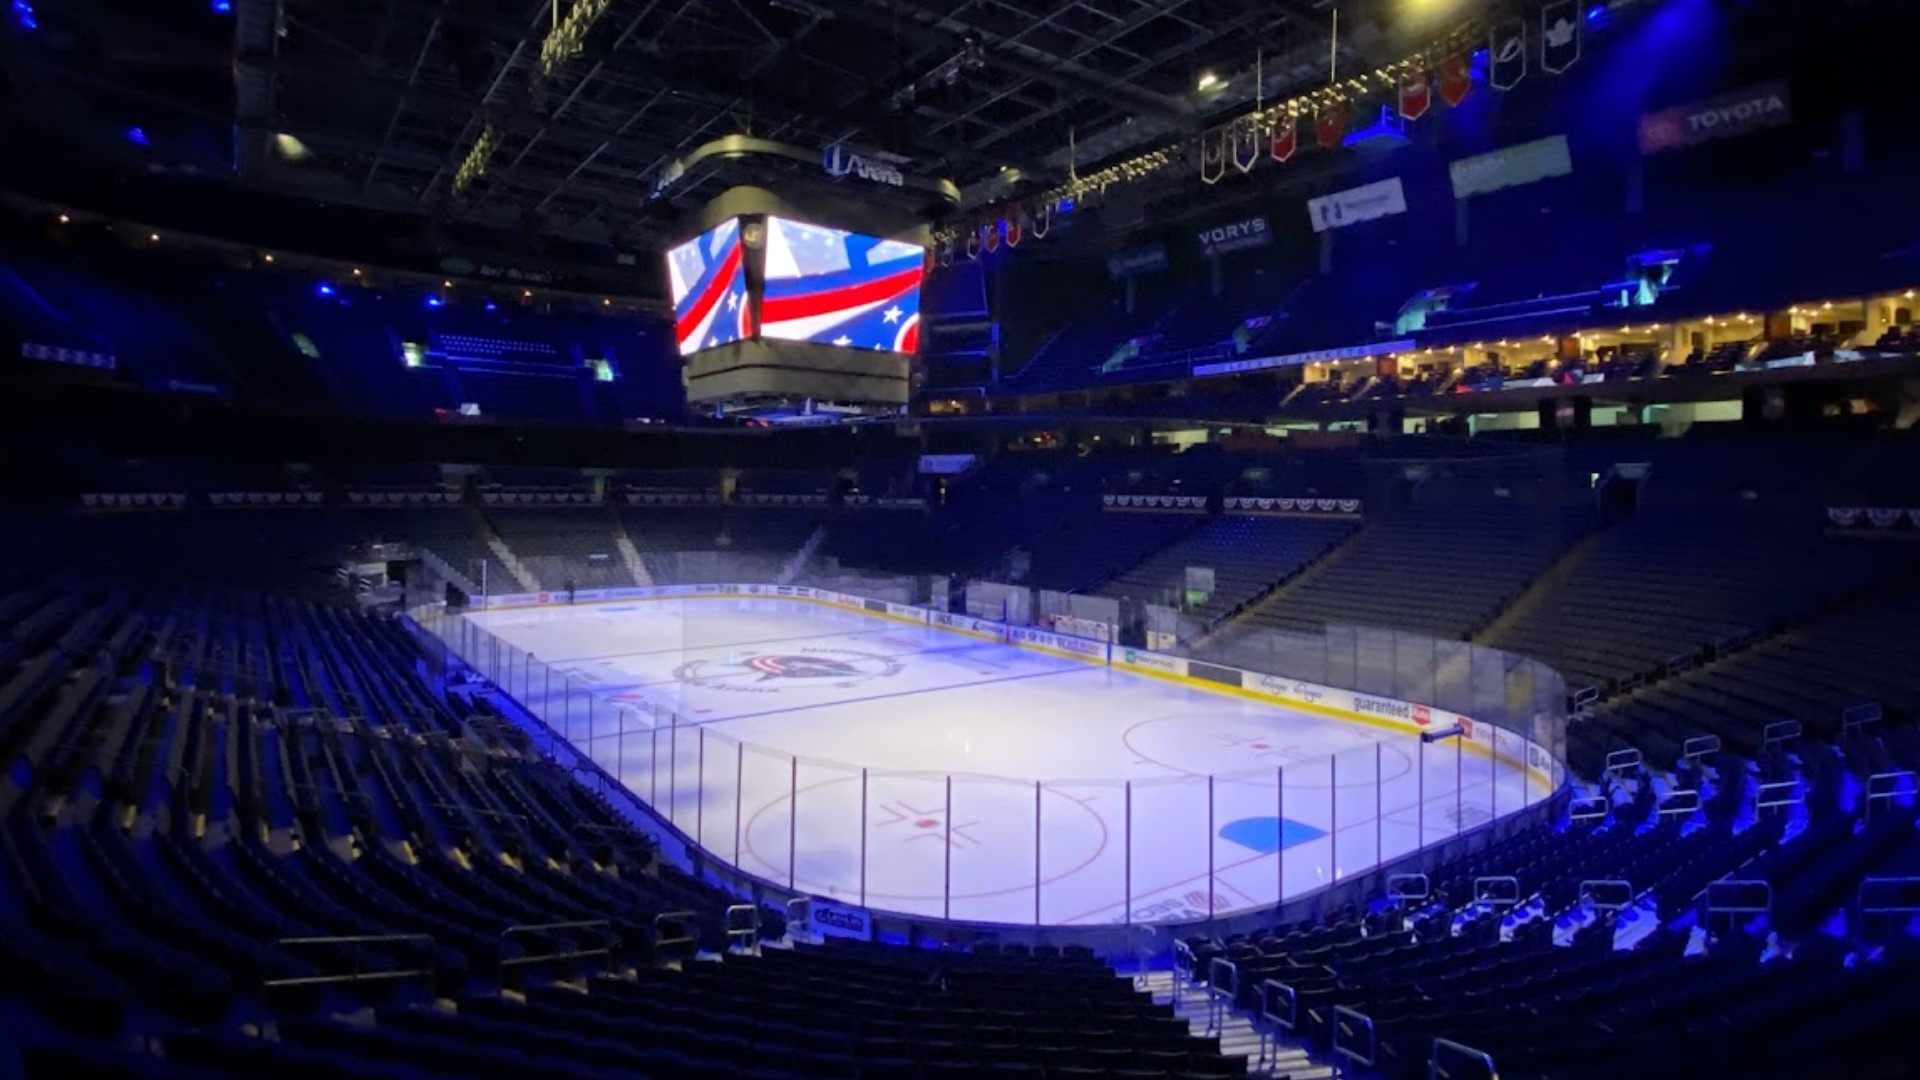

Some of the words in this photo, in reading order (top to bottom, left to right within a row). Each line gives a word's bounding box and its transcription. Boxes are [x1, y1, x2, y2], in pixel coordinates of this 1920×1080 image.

[1687, 96, 1784, 130] TOYOTA
[844, 154, 903, 187] Arena
[1199, 217, 1266, 244] VORYS
[1353, 697, 1409, 719] guaranteed
